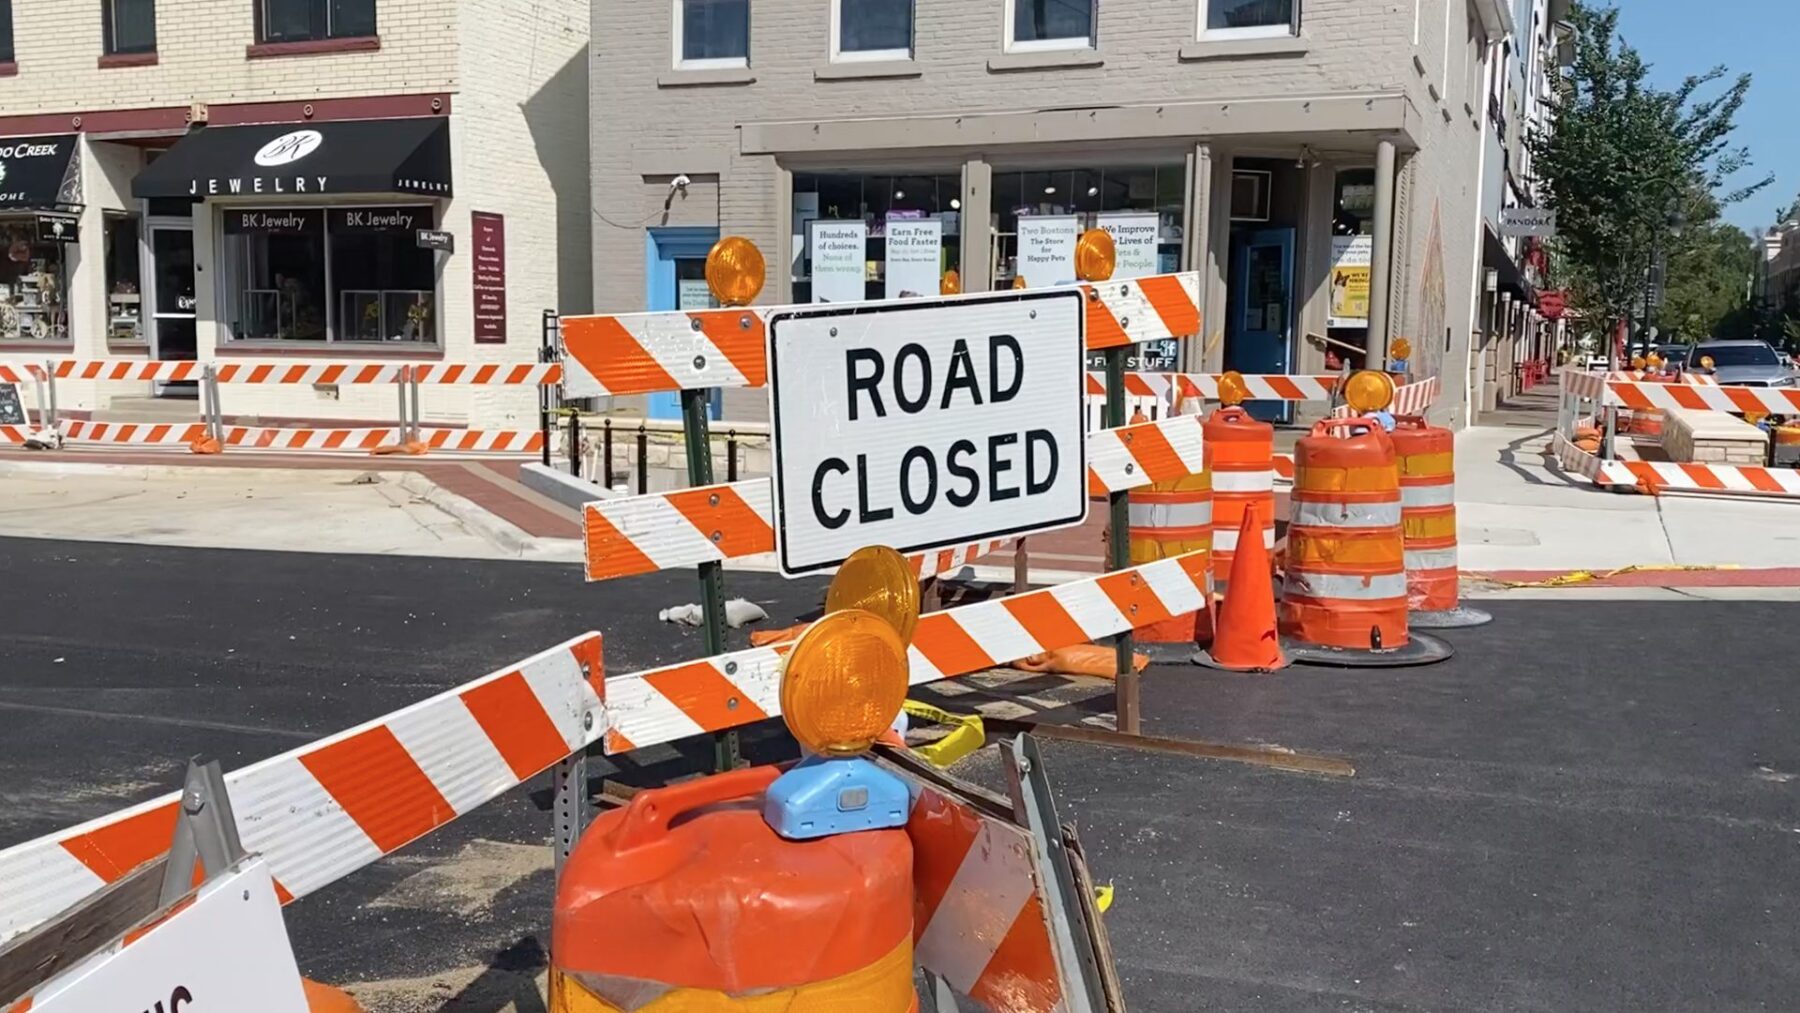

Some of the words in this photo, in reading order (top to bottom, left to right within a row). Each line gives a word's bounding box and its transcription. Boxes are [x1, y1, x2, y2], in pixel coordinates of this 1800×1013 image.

[14, 143, 58, 158] CREEK
[189, 177, 327, 194] JEWELRY
[398, 179, 449, 192] JEWELRY
[242, 214, 258, 227] BK
[261, 212, 305, 231] Jewelry
[347, 212, 363, 227] BK
[366, 211, 413, 229] Jewelry
[891, 228, 911, 237] Earn
[914, 228, 933, 237] Free
[1021, 227, 1039, 235] Two
[1041, 225, 1074, 234] Bostons
[1118, 224, 1155, 234] Improve
[420, 232, 428, 241] BK
[428, 232, 448, 244] Jewelry
[820, 230, 858, 239] Hundreds
[888, 237, 908, 246] Food
[911, 237, 938, 246] Faster
[1119, 236, 1143, 245] Lives
[1144, 235, 1154, 244] of
[818, 242, 827, 251] of
[828, 242, 859, 251] choices.
[823, 253, 842, 261] None
[844, 253, 853, 261] of
[1027, 255, 1049, 263] Happy
[815, 265, 834, 273] them
[1127, 357, 1174, 368] STUFF
[846, 334, 1025, 421] ROAD
[811, 428, 1059, 530] CLOSED
